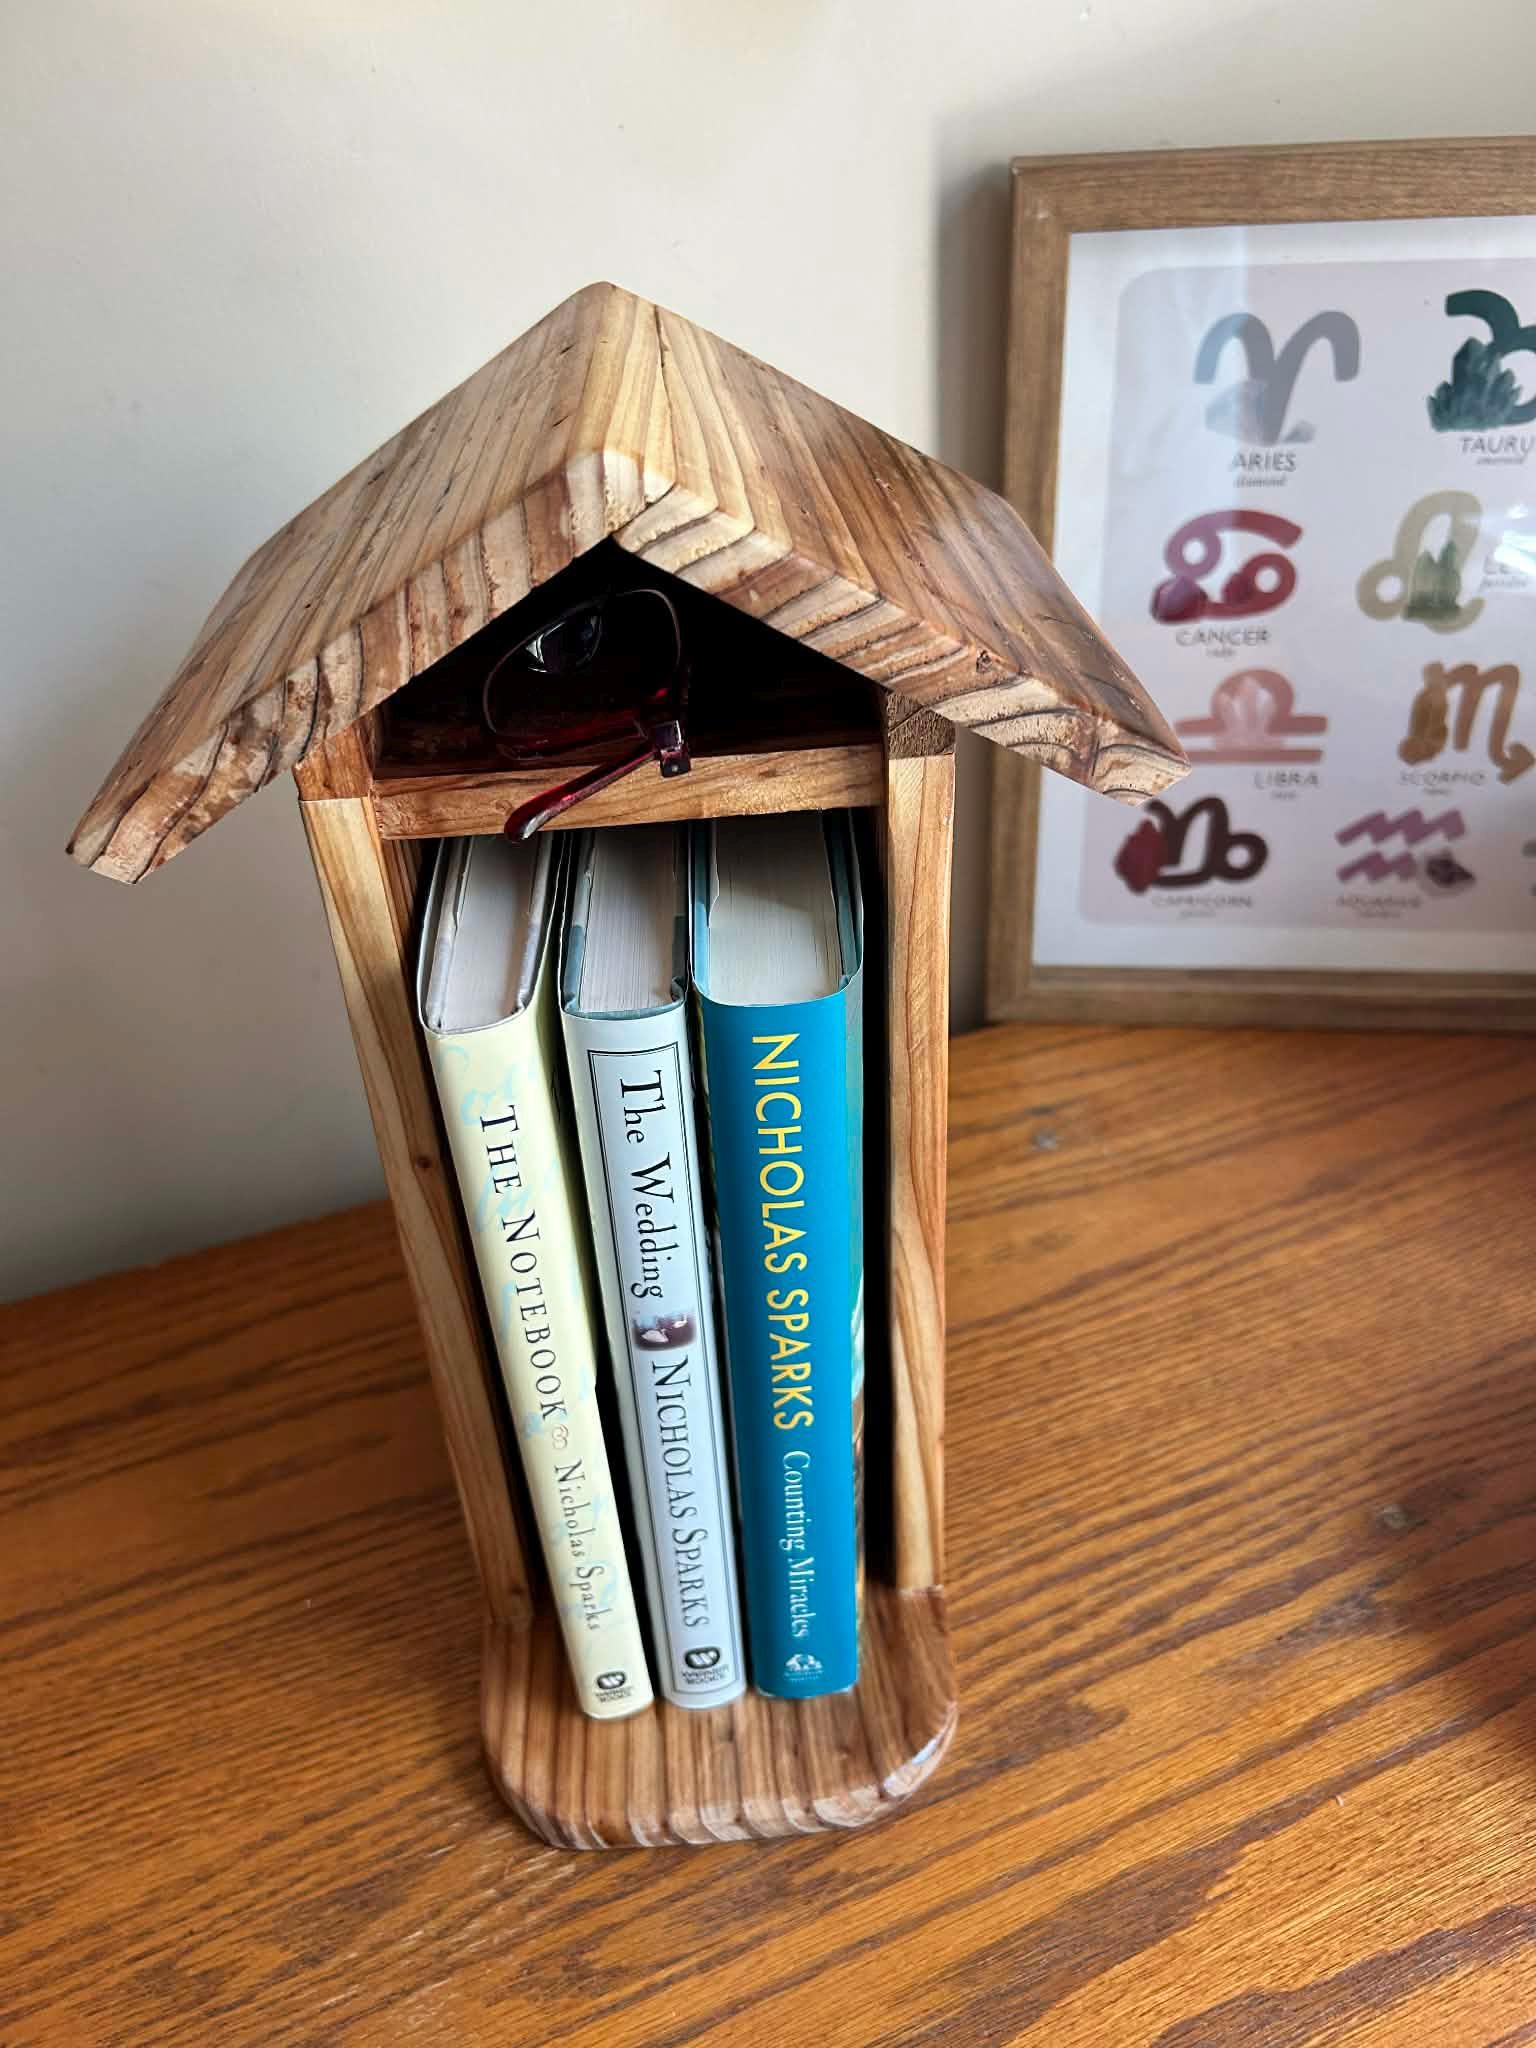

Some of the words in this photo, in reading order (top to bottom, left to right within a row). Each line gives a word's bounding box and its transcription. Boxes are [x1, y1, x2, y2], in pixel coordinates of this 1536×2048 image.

[1231, 451, 1296, 472] ARIES
[1176, 627, 1270, 647] CANCER
[1254, 770, 1319, 789] LIBRA
[620, 1069, 666, 1144] The
[751, 1032, 808, 1273] NICHOLAS
[480, 1104, 521, 1194] THE
[502, 1209, 567, 1420] NOTEBOOK
[630, 1152, 680, 1299] Wedding
[766, 1288, 814, 1430] SPARKS
[652, 1355, 698, 1519] NICHOLAS
[554, 1458, 597, 1558] Nicholas
[779, 1450, 812, 1551] Counting
[569, 1565, 613, 1631] Sparks
[672, 1528, 710, 1628] SPARKS
[787, 1556, 816, 1638] Miracles
